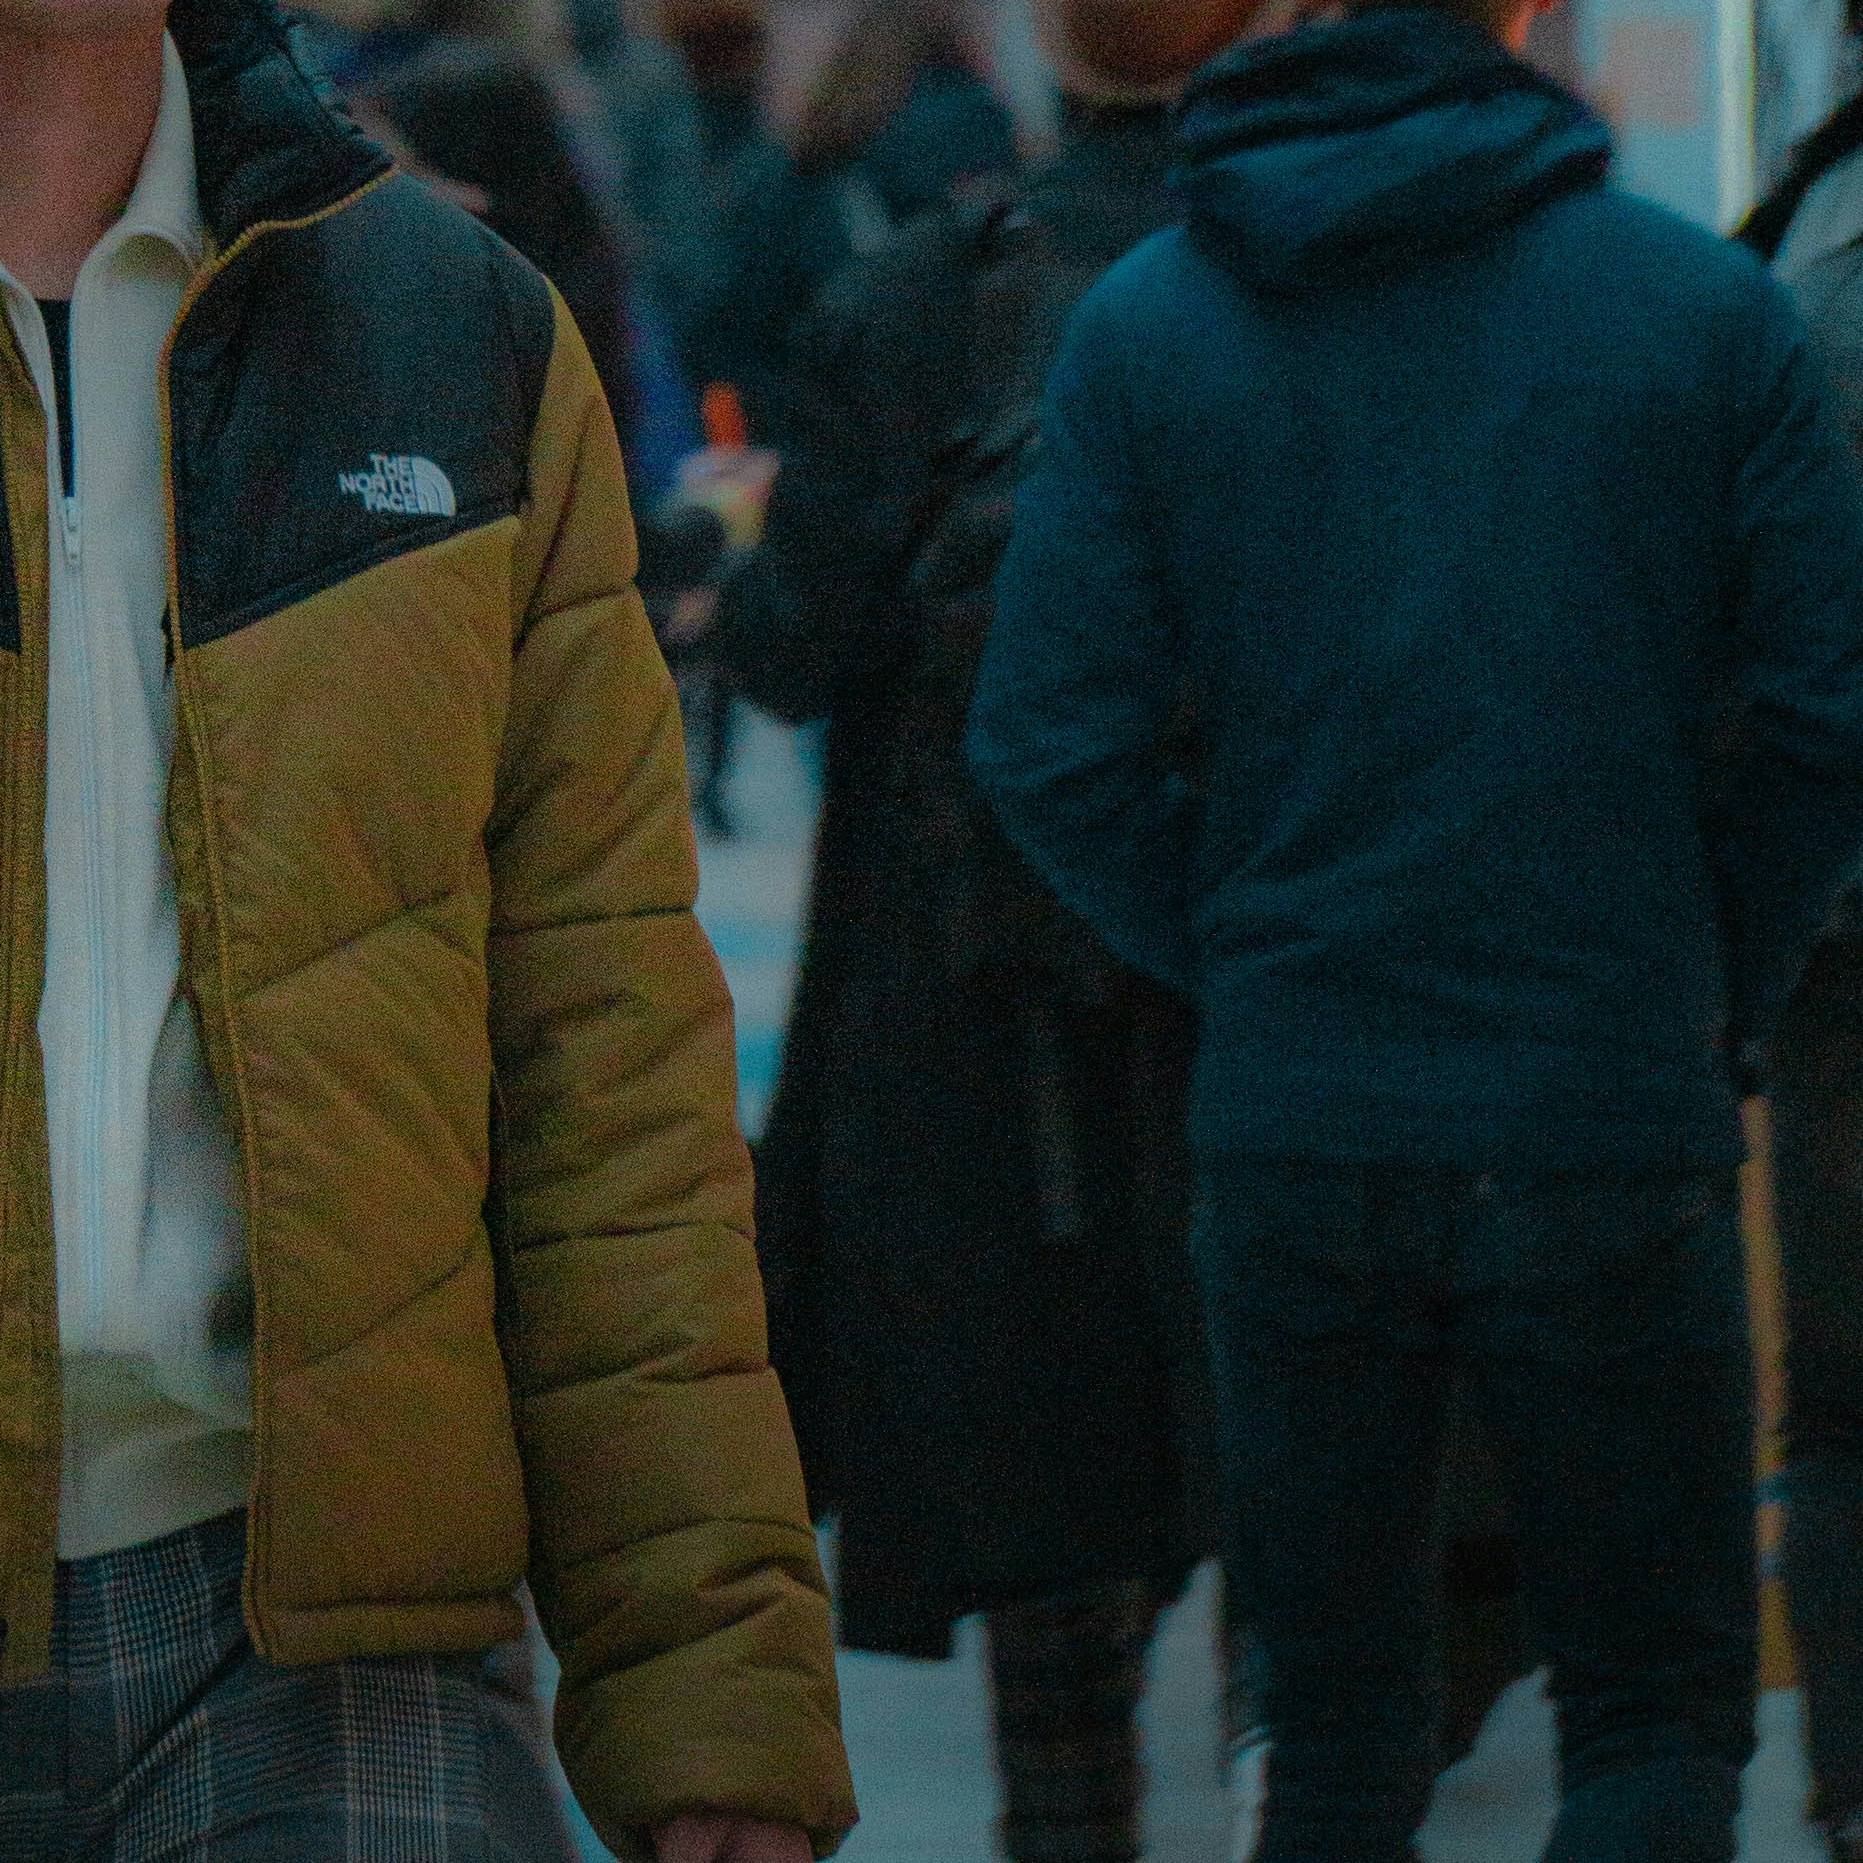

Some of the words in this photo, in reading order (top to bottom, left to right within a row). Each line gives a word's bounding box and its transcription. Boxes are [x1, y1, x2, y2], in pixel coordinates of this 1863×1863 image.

[369, 452, 412, 475] THE
[338, 472, 415, 497] NORTH
[364, 492, 420, 514] FACE
